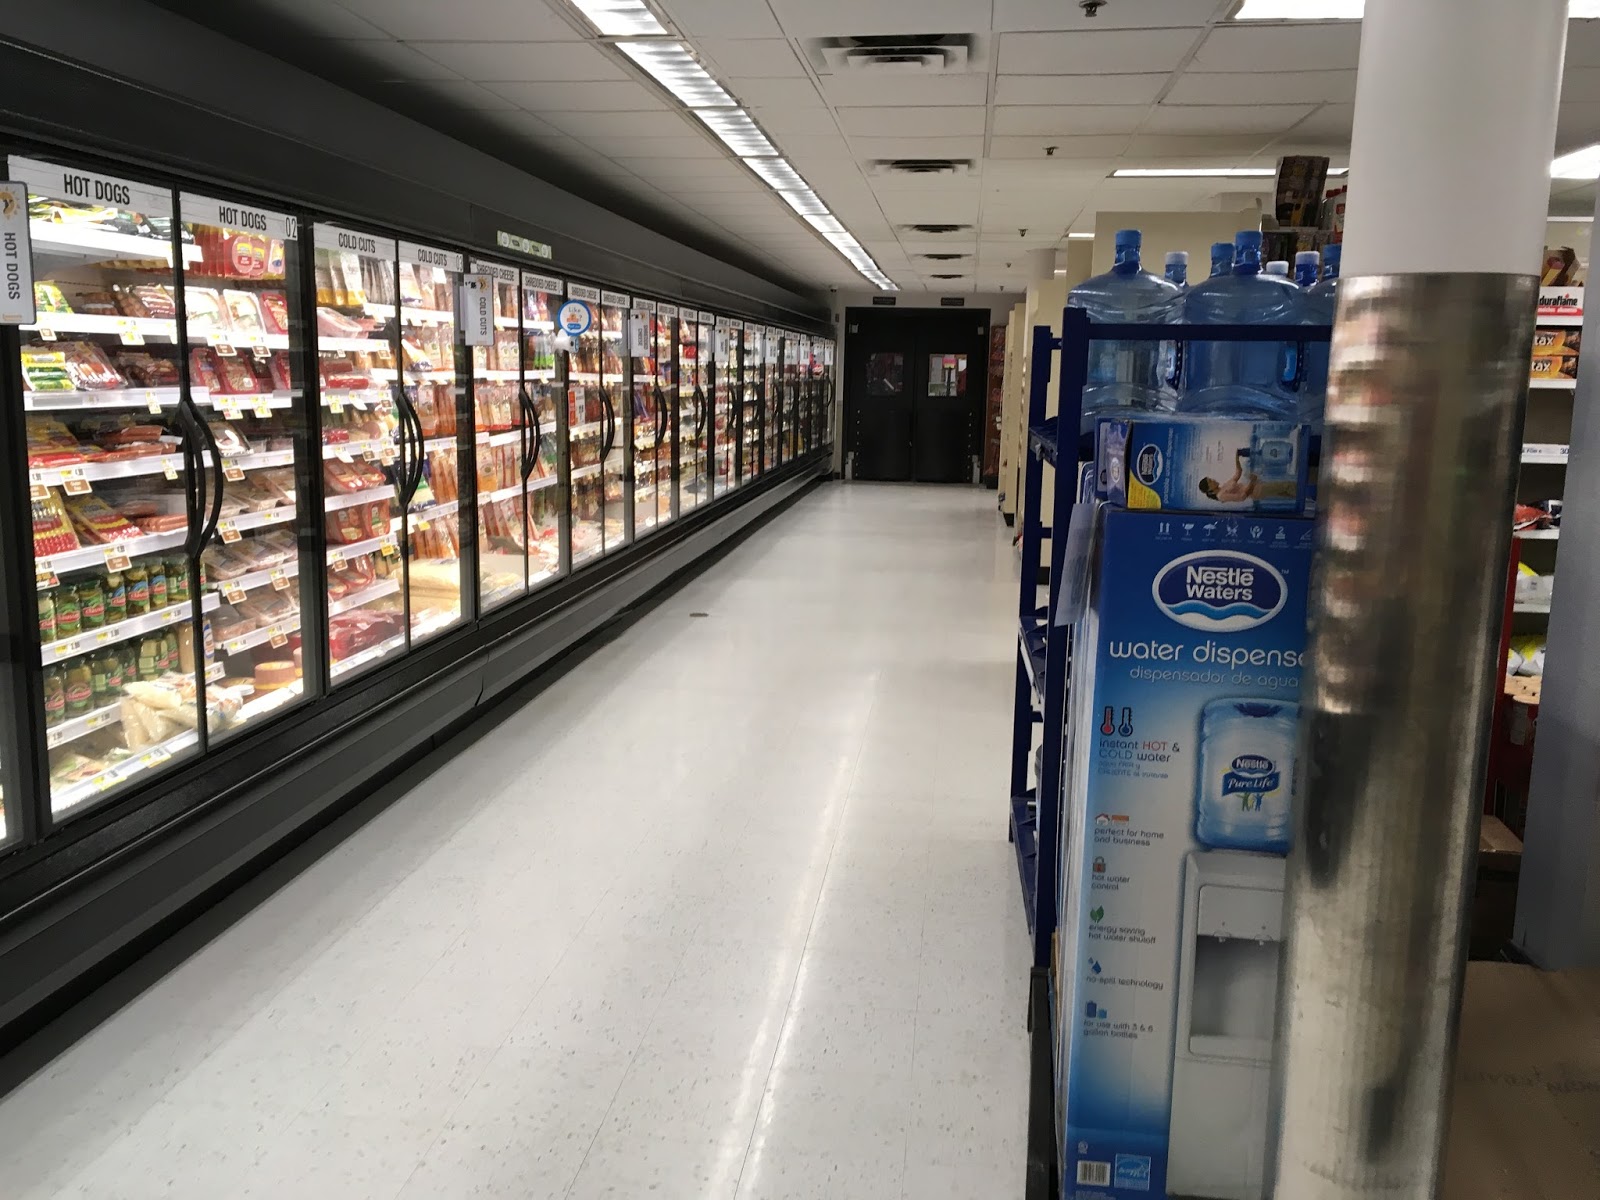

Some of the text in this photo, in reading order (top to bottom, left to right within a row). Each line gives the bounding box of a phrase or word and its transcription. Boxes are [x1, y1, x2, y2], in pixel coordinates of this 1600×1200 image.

[63, 173, 131, 205] HOT DOGS
[218, 205, 267, 231] HOT DOGS
[285, 217, 297, 238] 02
[338, 232, 376, 253] COLD CUTS
[4, 232, 20, 300] HOT DOGS
[417, 248, 448, 267] COLD CUTS
[499, 267, 515, 281] CHEESE
[479, 297, 487, 316] COLD
[1539, 294, 1578, 306] duraflame
[1186, 584, 1253, 601] Waters
[1109, 640, 1184, 661] water
[1130, 665, 1299, 691] dispensador de agua
[1099, 739, 1180, 752] instant HOT &
[1099, 749, 1171, 762] COLD water
[1094, 828, 1164, 839] perfect for home
[1112, 837, 1151, 847] business
[1118, 978, 1164, 991] technology
